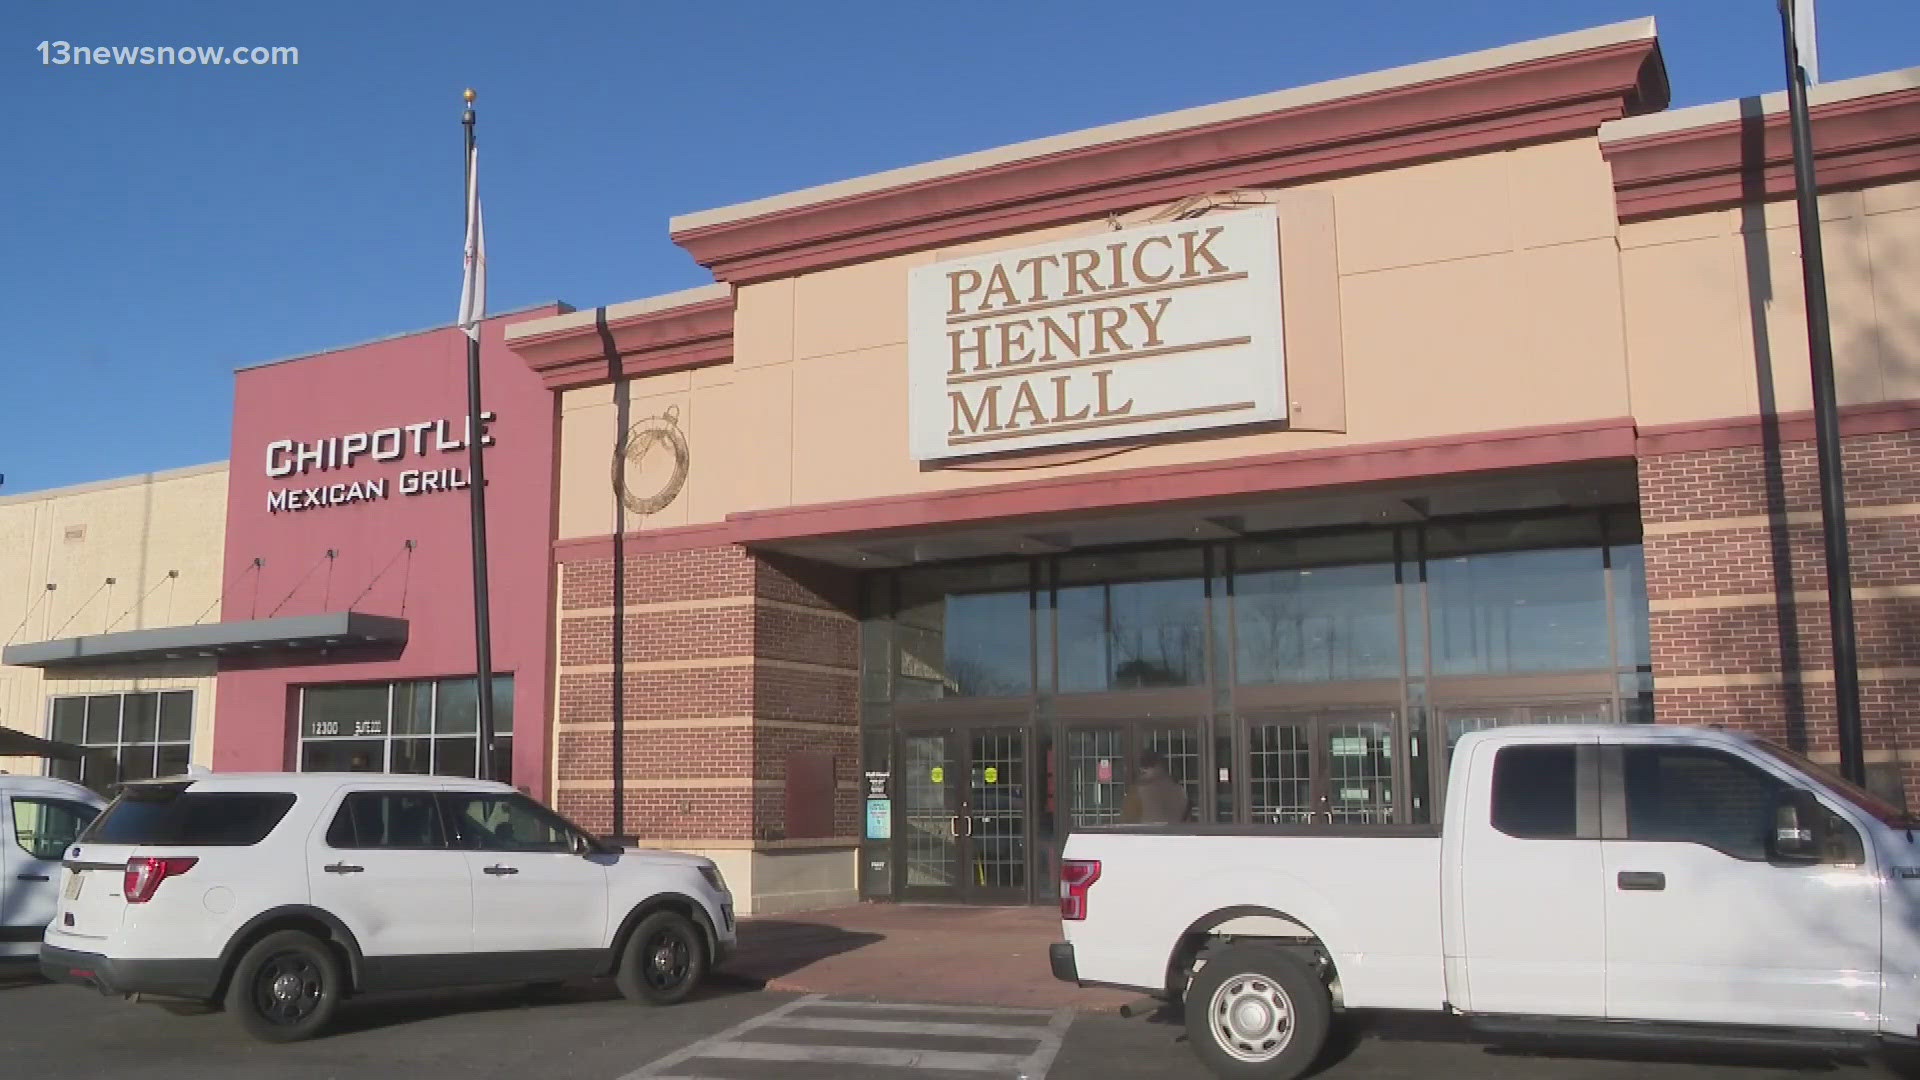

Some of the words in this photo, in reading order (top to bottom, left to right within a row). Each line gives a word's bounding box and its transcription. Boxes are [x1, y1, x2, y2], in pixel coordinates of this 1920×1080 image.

[946, 226, 1229, 315] PATRICK
[946, 297, 1172, 375] HENRY
[947, 369, 1134, 436] MALL
[267, 477, 384, 513] MEXICAN
[399, 467, 474, 494] GRIL
[312, 721, 338, 735] 12300
